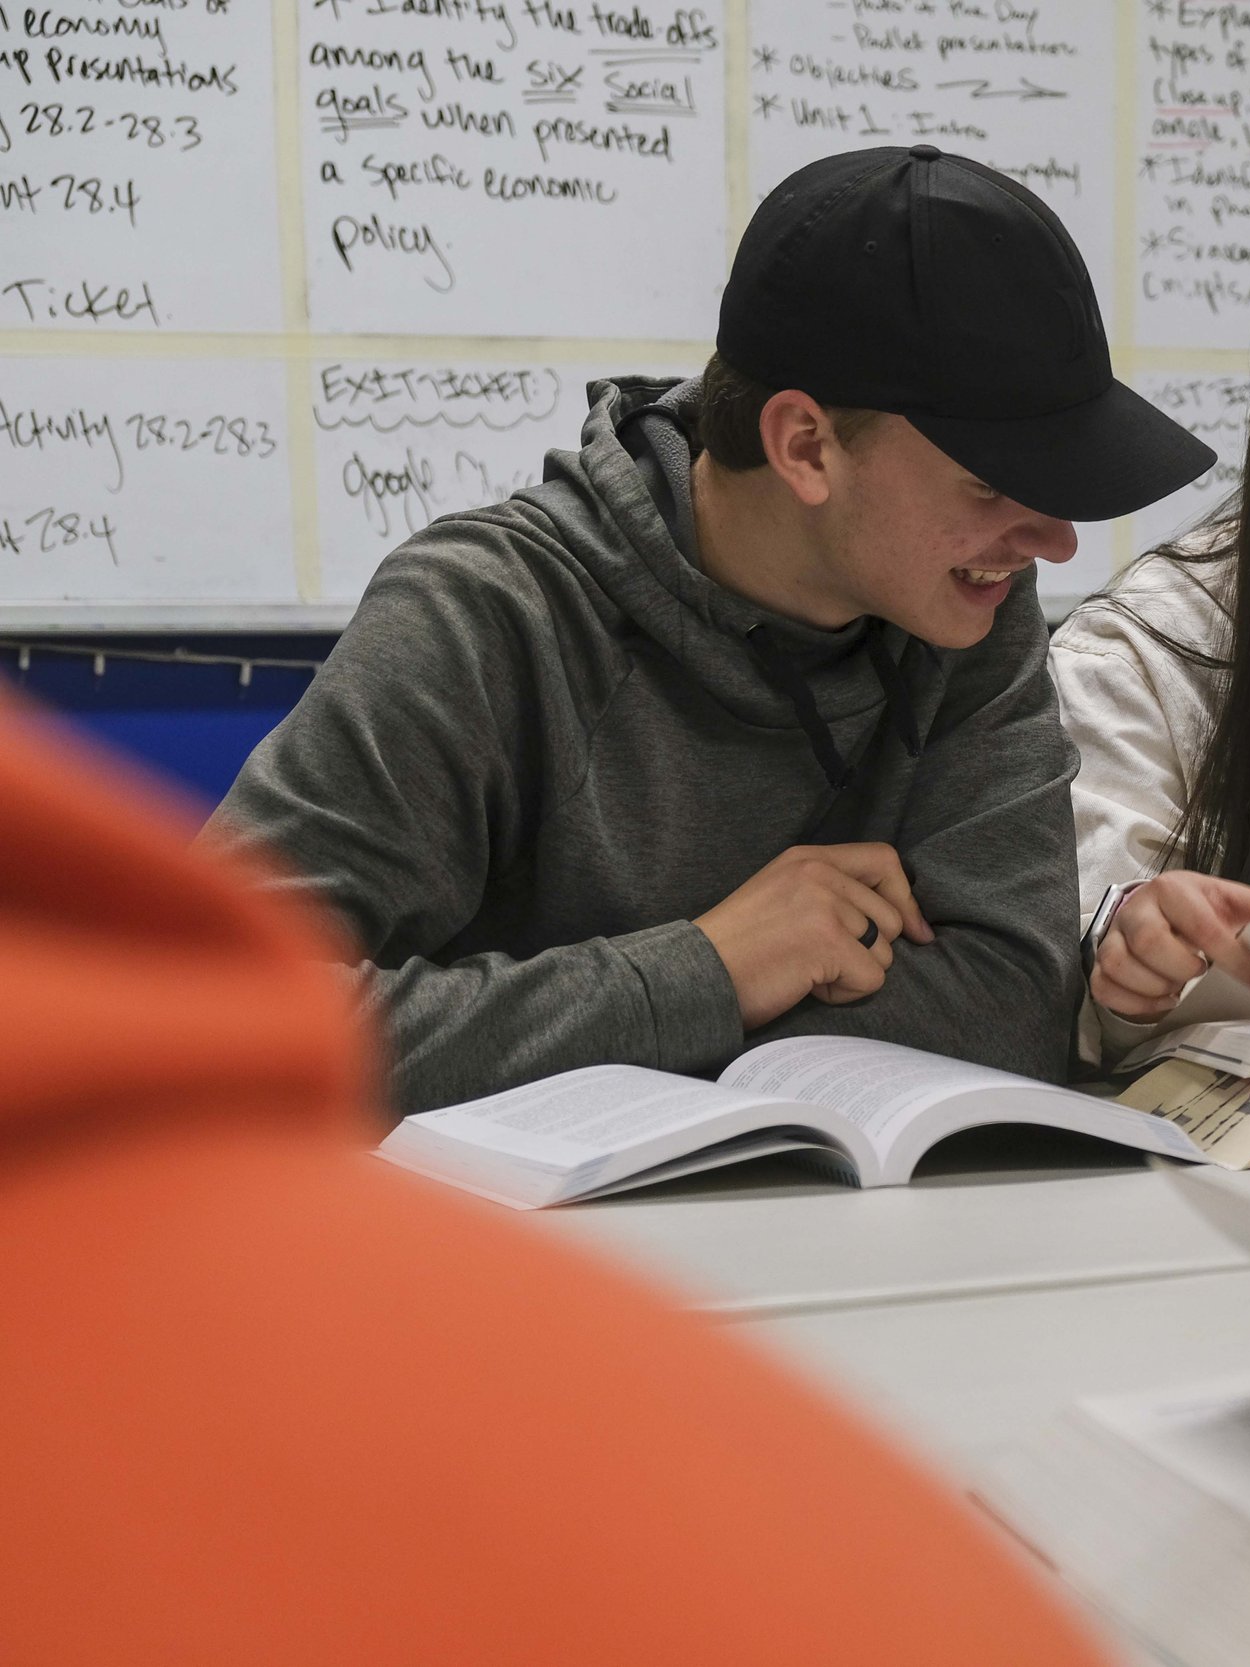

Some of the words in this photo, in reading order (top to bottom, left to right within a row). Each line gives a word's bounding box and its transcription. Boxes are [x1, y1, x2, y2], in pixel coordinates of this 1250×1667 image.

[24, 8, 168, 57] economy
[310, 42, 436, 100] among
[444, 49, 505, 84] the
[526, 60, 584, 90] six
[20, 102, 204, 151] 28.2-28.3
[315, 85, 410, 144] goals
[421, 105, 516, 139] when
[532, 115, 674, 163] presented
[50, 173, 142, 228] 28.4
[321, 160, 344, 186] a
[484, 169, 619, 204] economic
[320, 363, 418, 404] EXIT
[125, 413, 278, 459] 28.2-28.3
[25, 506, 118, 568] 28.4
